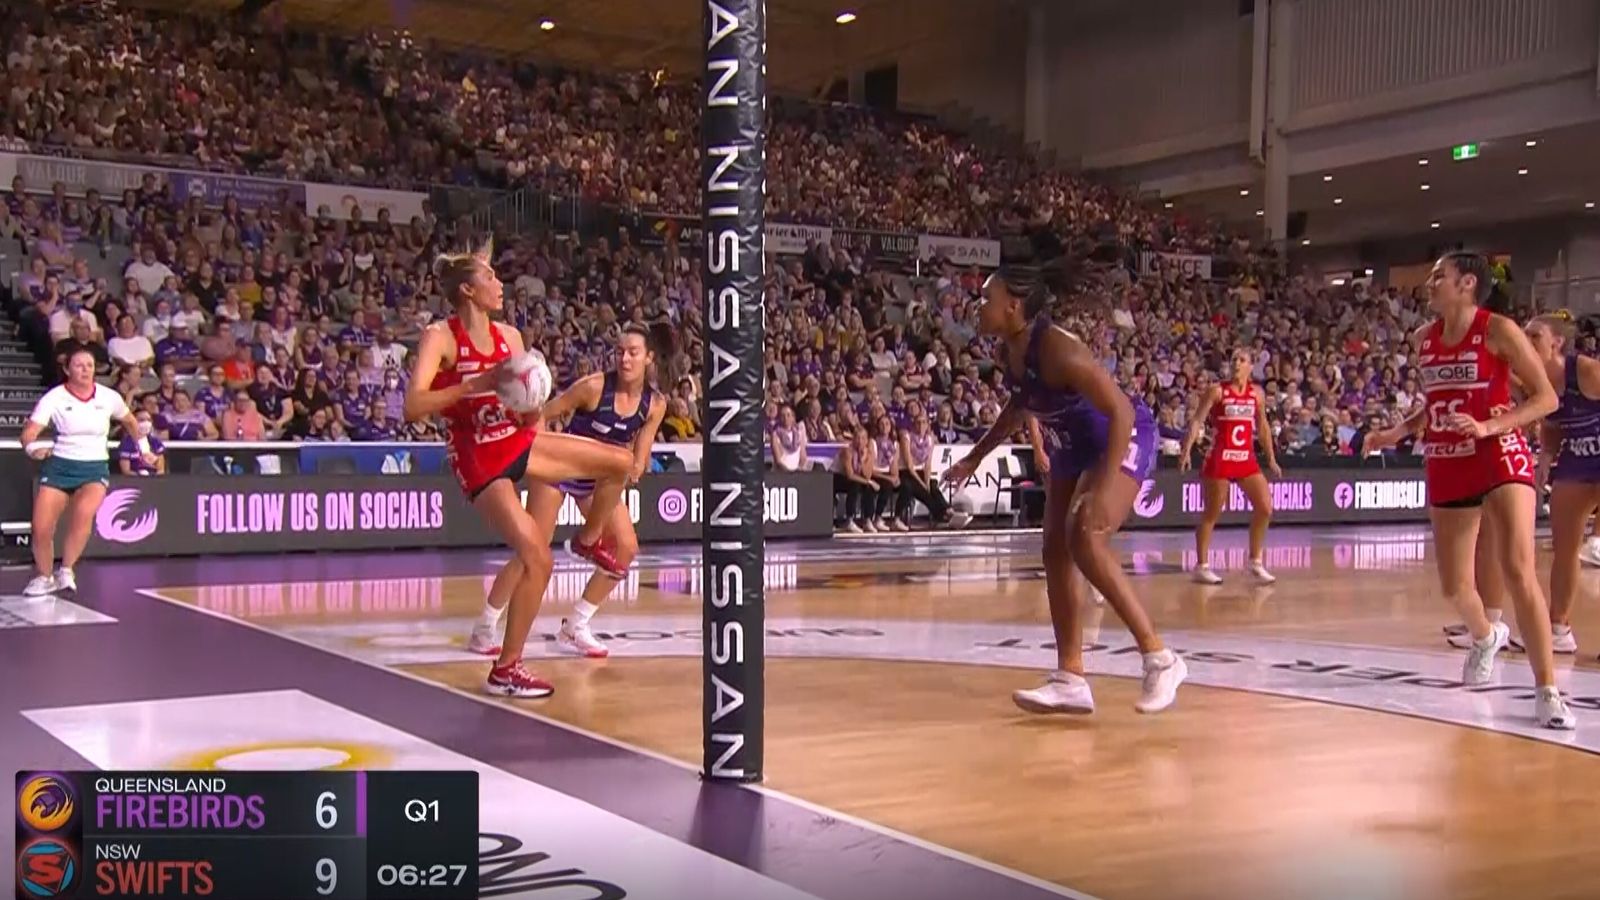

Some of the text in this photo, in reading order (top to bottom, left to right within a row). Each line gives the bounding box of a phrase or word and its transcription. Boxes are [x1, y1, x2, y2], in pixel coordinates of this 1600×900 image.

[881, 235, 916, 252] VALOUR
[708, 145, 743, 444] NISSAN
[1231, 424, 1246, 447] C
[1500, 453, 1532, 478] 12
[197, 491, 443, 534] FOLLOW US ON SOCIALS
[709, 482, 745, 778] NISSAN
